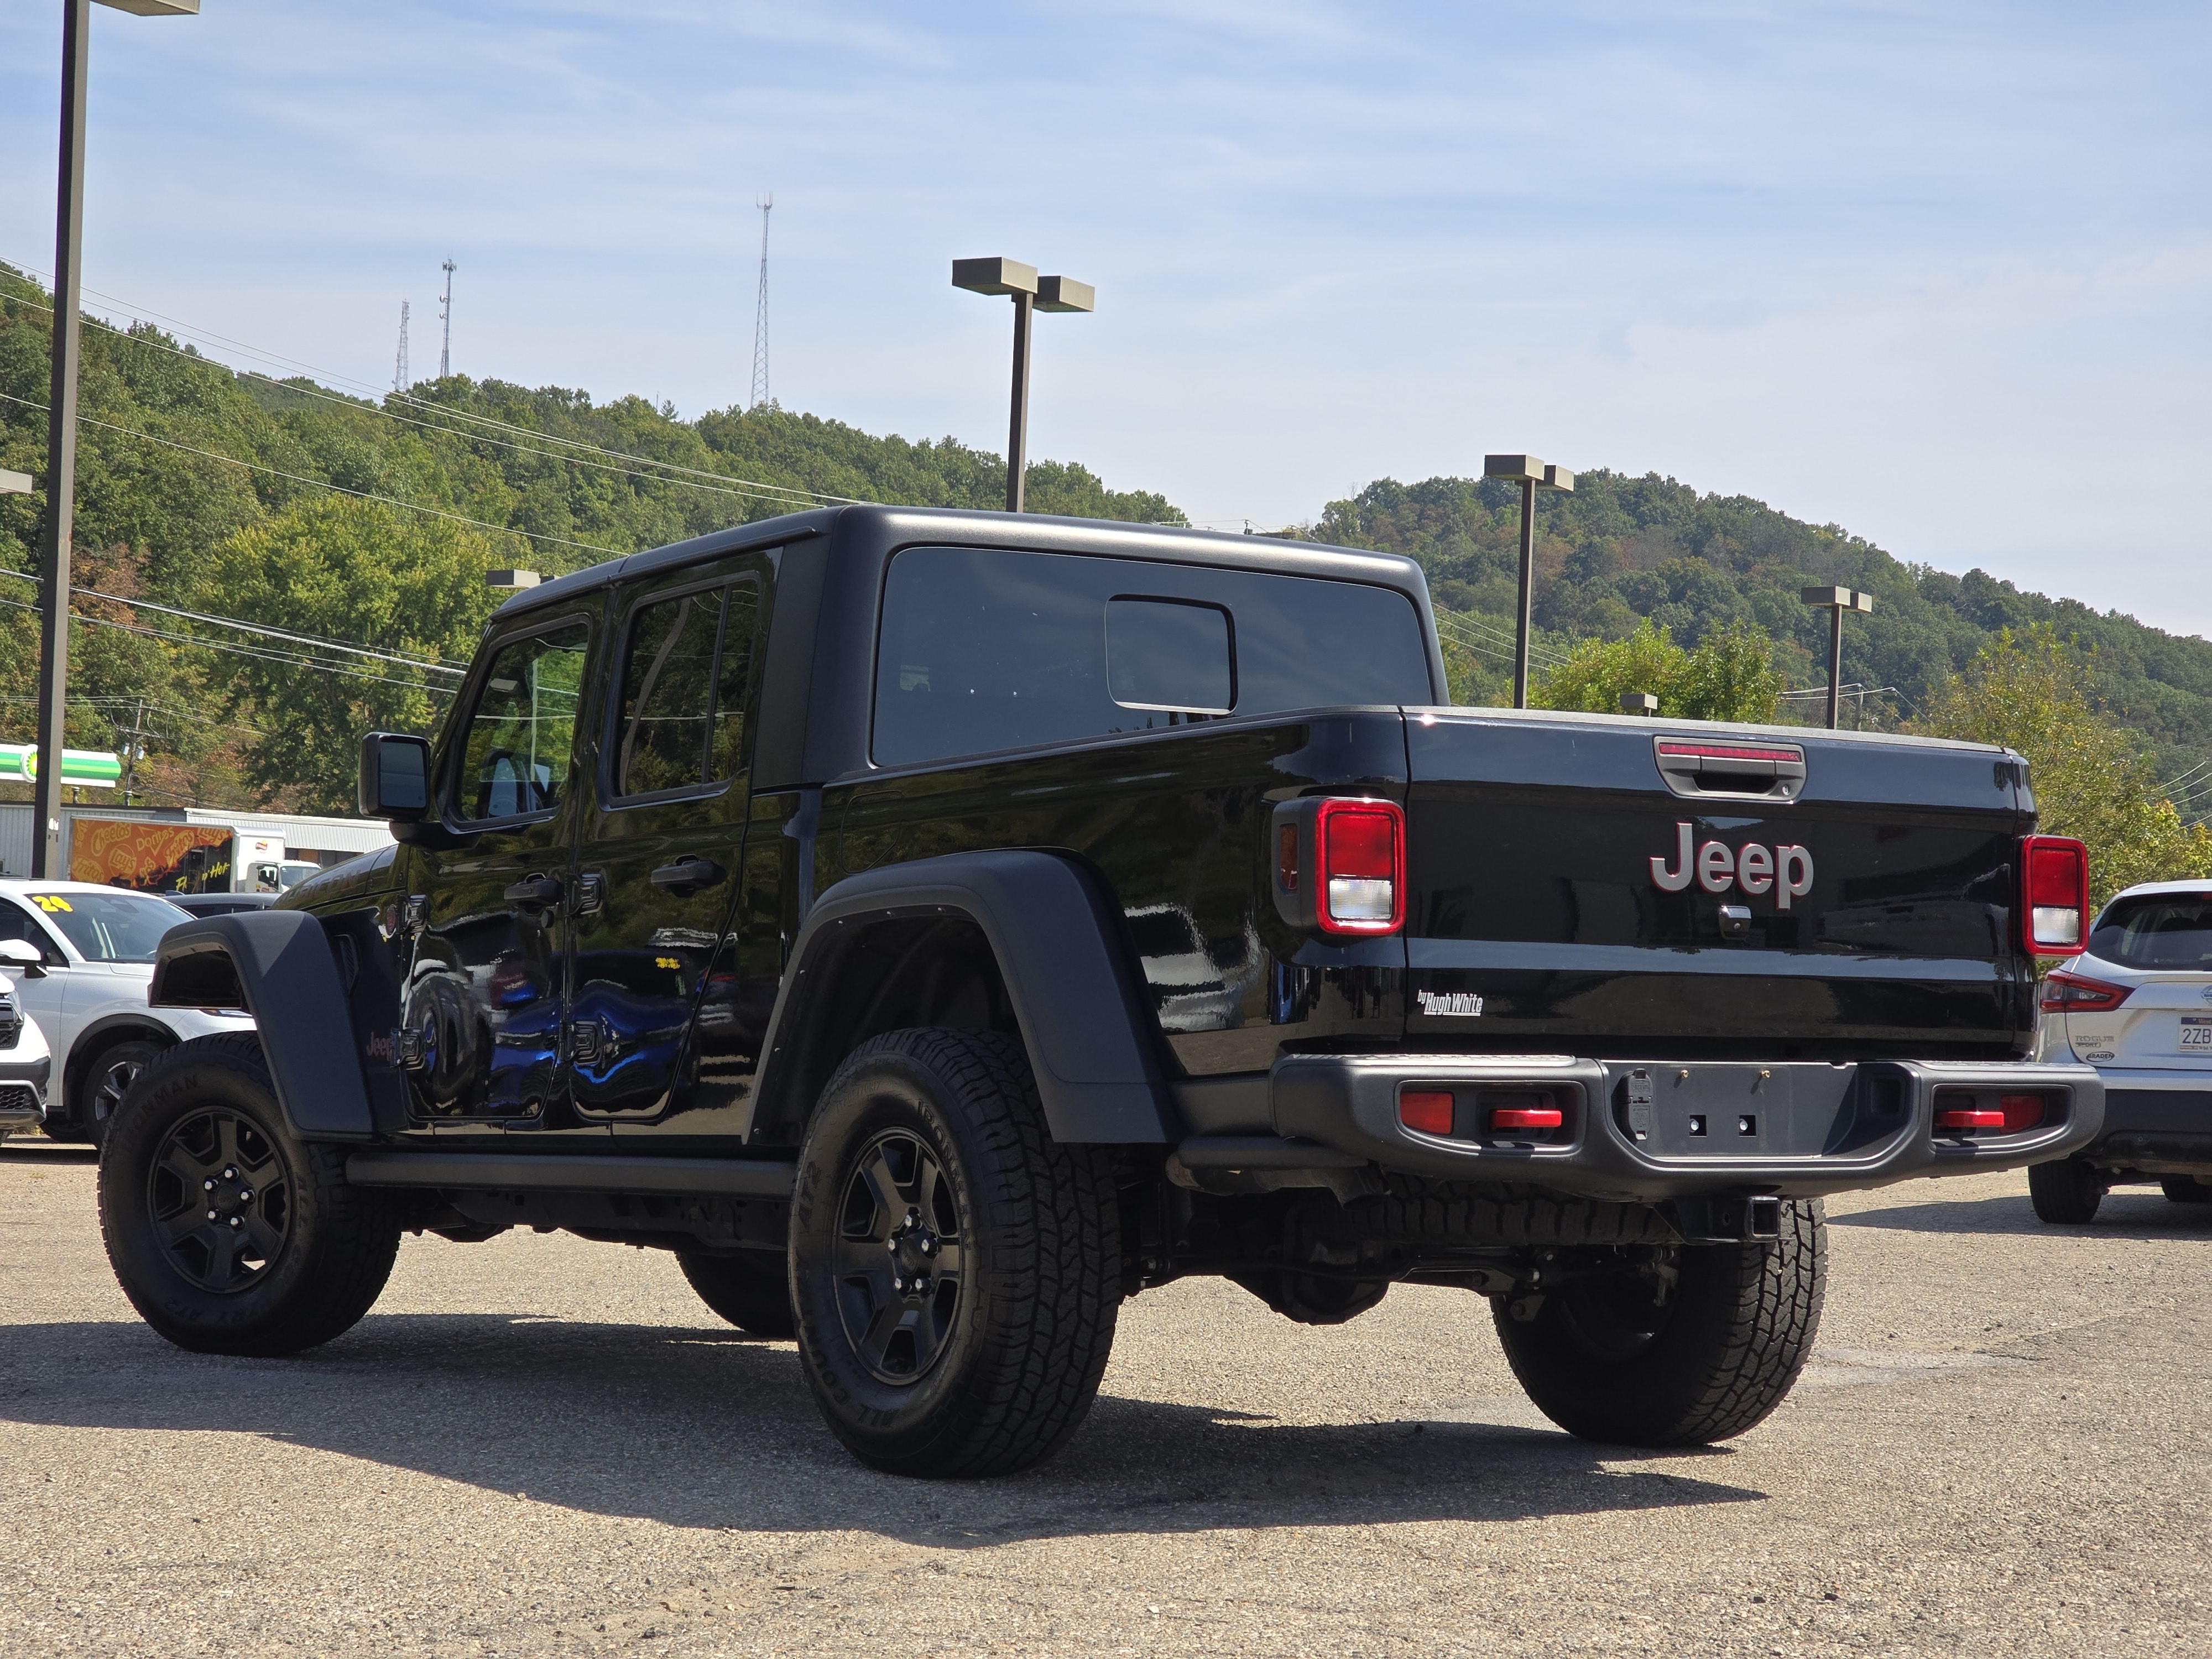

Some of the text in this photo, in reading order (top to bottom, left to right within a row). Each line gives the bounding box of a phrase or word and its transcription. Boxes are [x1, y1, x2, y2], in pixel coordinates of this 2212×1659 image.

[91, 822, 131, 856] Cheetos
[136, 826, 174, 851] Doritos
[72, 859, 104, 881] Fritos
[210, 862, 230, 878] Hot
[1648, 822, 1814, 911] Jeep
[1417, 989, 1483, 1015] by Hugh White
[916, 1099, 972, 1251] IRONMAN
